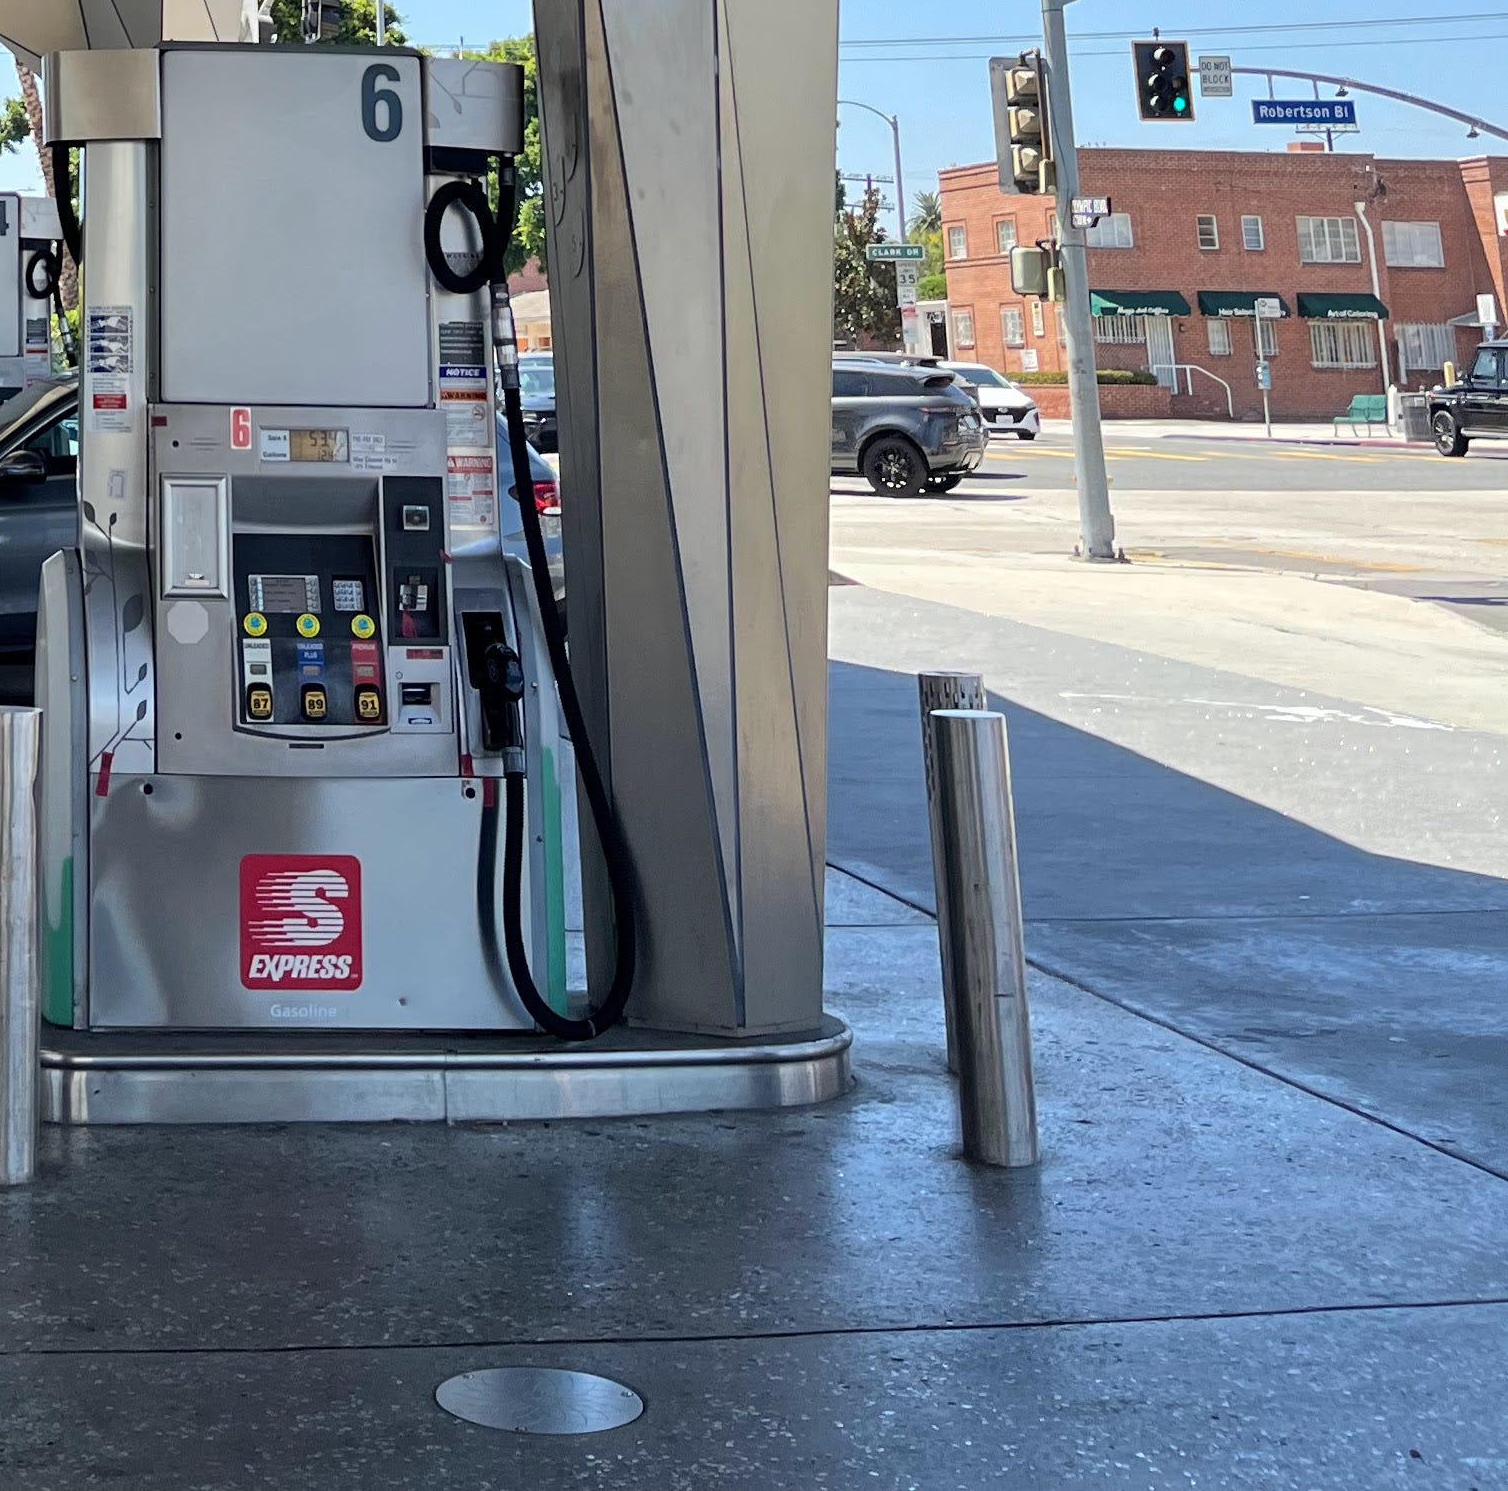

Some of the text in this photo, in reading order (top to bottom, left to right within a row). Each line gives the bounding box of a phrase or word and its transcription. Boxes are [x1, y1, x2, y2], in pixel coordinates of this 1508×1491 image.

[1201, 61, 1229, 71] DO NOT
[1202, 74, 1230, 84] BLOCK
[361, 63, 403, 143] 6
[1259, 105, 1349, 119] Robertson Bl
[872, 248, 902, 257] CLARK
[899, 274, 916, 284] 35
[445, 368, 481, 377] NOTICE
[446, 391, 487, 400] WARNING
[232, 408, 250, 448] 6
[262, 451, 287, 459] Gallons
[456, 457, 492, 469] WARNING
[244, 642, 269, 650] UNLEADED
[303, 651, 318, 659] PLUS
[253, 698, 269, 709] 87
[307, 699, 324, 710] 89
[360, 700, 378, 711] 91
[249, 869, 349, 947] S
[248, 954, 353, 982] EXPRESS
[270, 1003, 338, 1018] Gasoline
